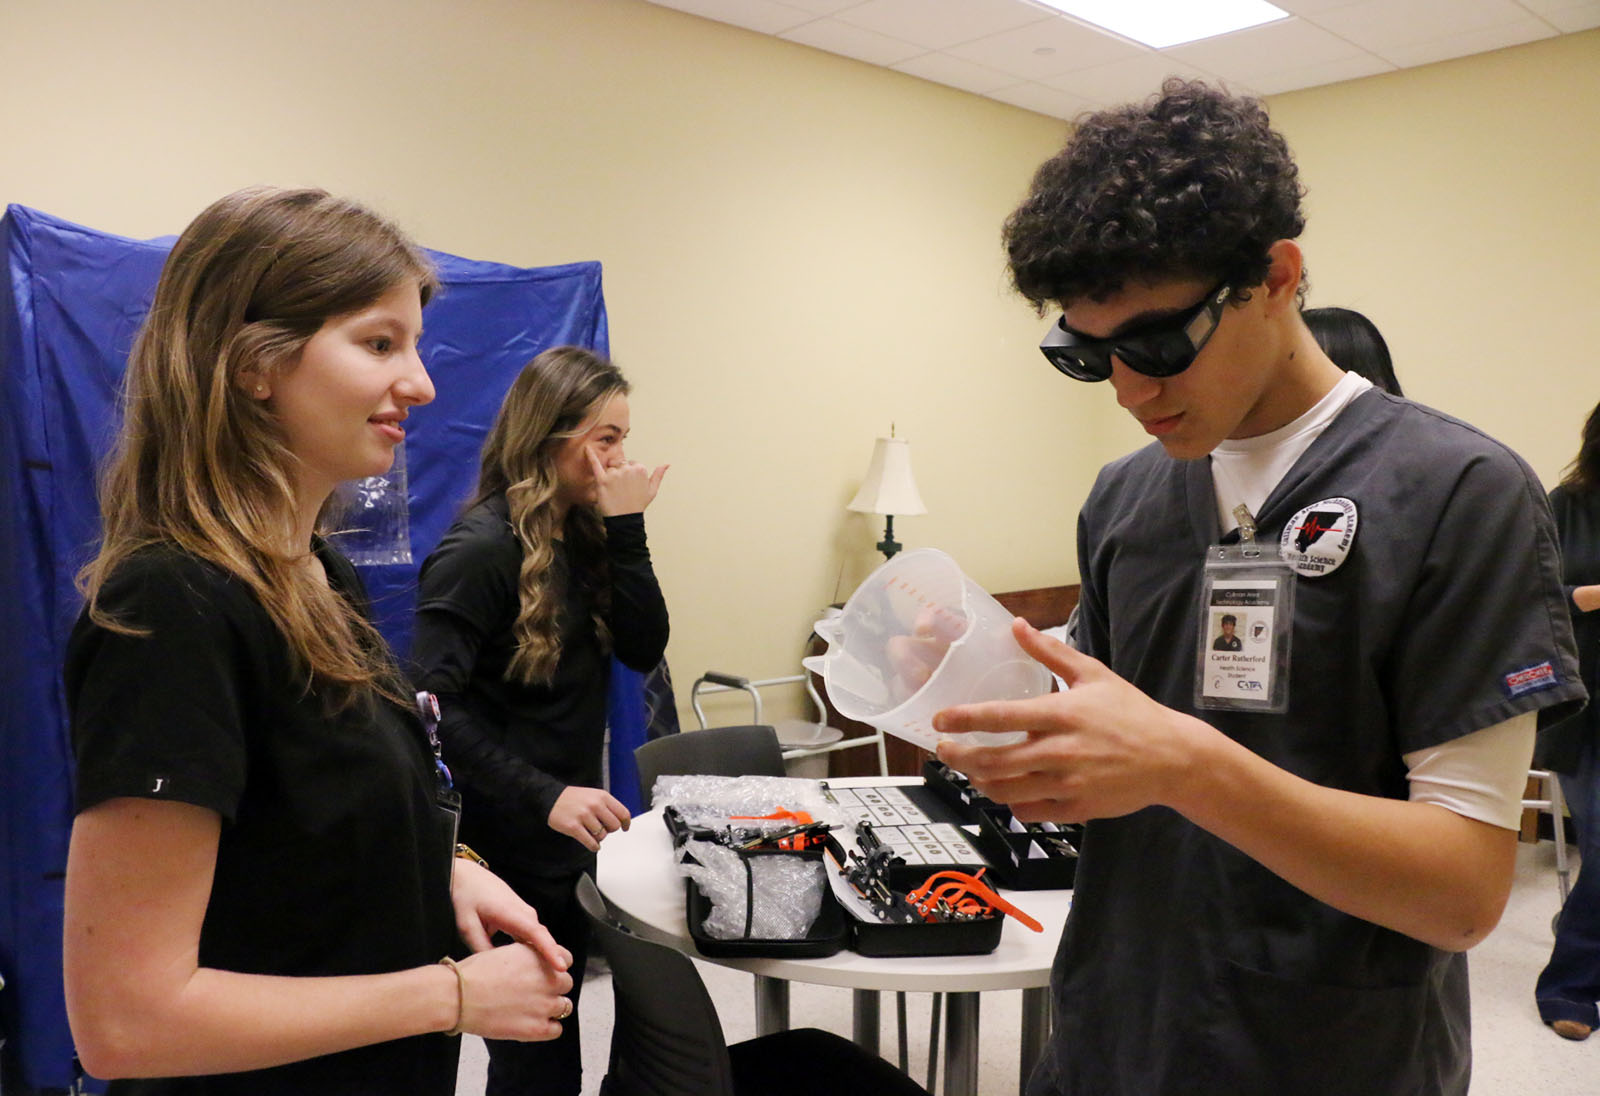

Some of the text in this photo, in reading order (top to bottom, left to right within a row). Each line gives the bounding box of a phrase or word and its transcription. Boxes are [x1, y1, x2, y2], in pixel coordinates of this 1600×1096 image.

[1310, 555, 1336, 565] Science
[1232, 655, 1266, 663] Rutherford
[152, 778, 164, 793] J
